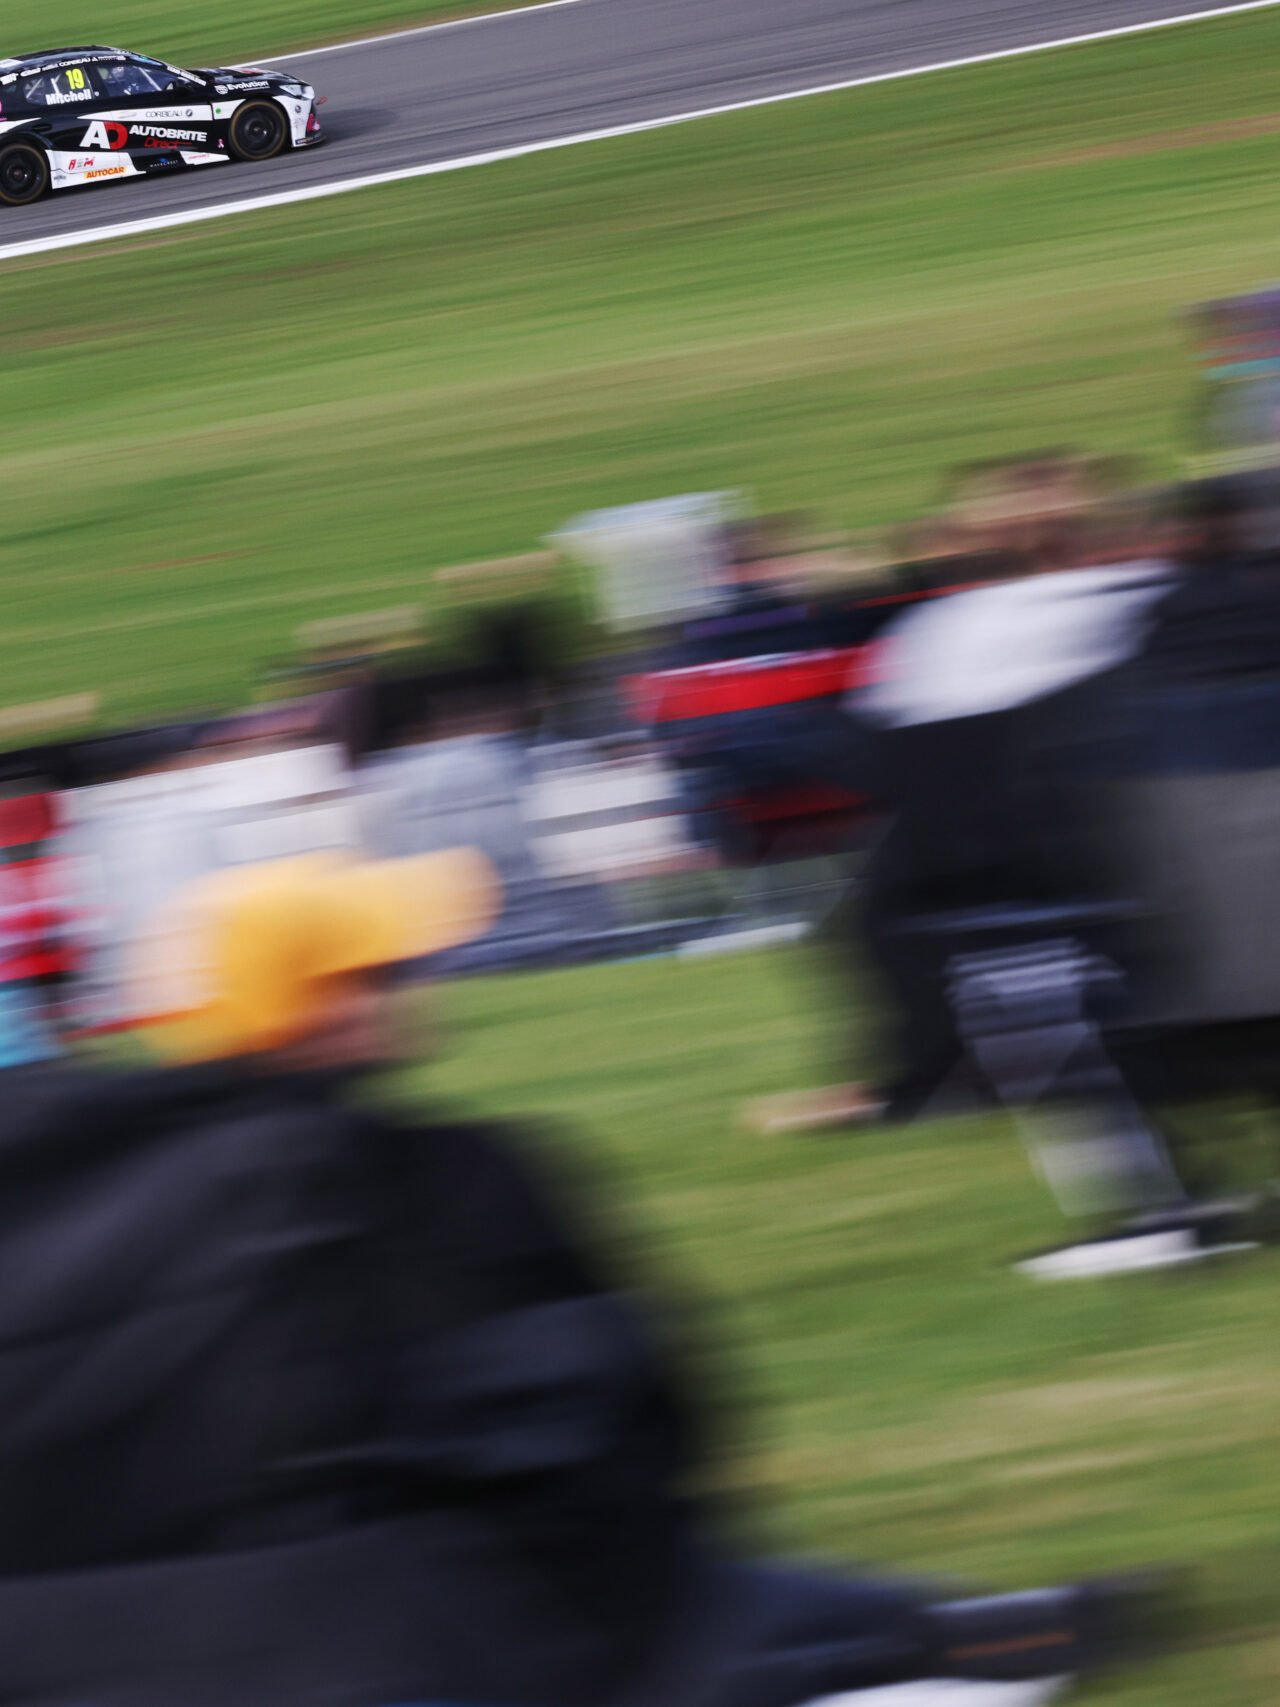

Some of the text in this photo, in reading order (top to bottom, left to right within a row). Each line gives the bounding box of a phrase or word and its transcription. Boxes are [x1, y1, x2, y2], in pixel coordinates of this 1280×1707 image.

[65, 68, 85, 90] 19
[228, 80, 269, 91] Evolution
[45, 88, 92, 105] Mitchell
[145, 110, 183, 118] CORBEAU
[79, 121, 128, 149] AD
[129, 124, 207, 142] AUTOBRITE
[144, 137, 192, 149] Direct
[86, 167, 125, 179] AUTOCAR
